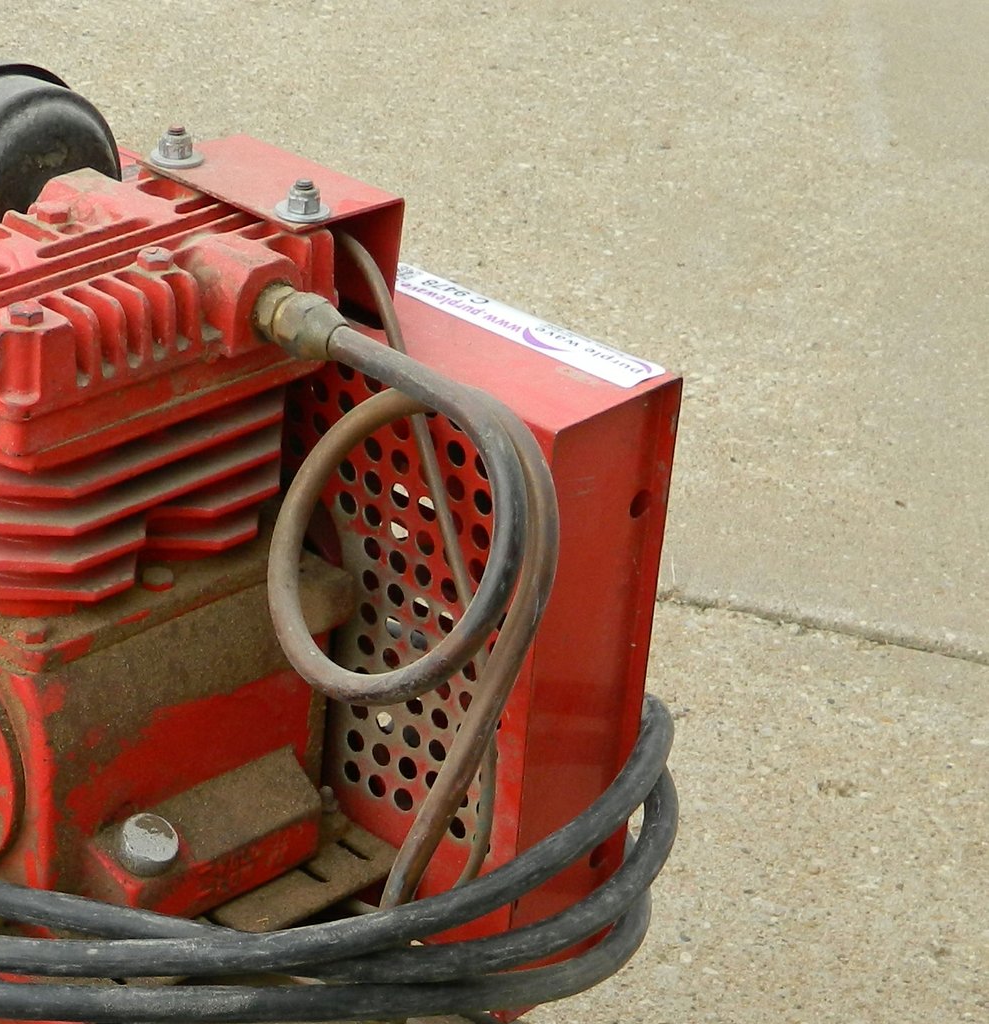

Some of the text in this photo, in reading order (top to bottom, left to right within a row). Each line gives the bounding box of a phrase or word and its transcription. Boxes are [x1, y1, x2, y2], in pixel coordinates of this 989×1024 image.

[420, 278, 490, 306] C 9478
[534, 326, 581, 348] wave
[584, 346, 645, 376] purple
